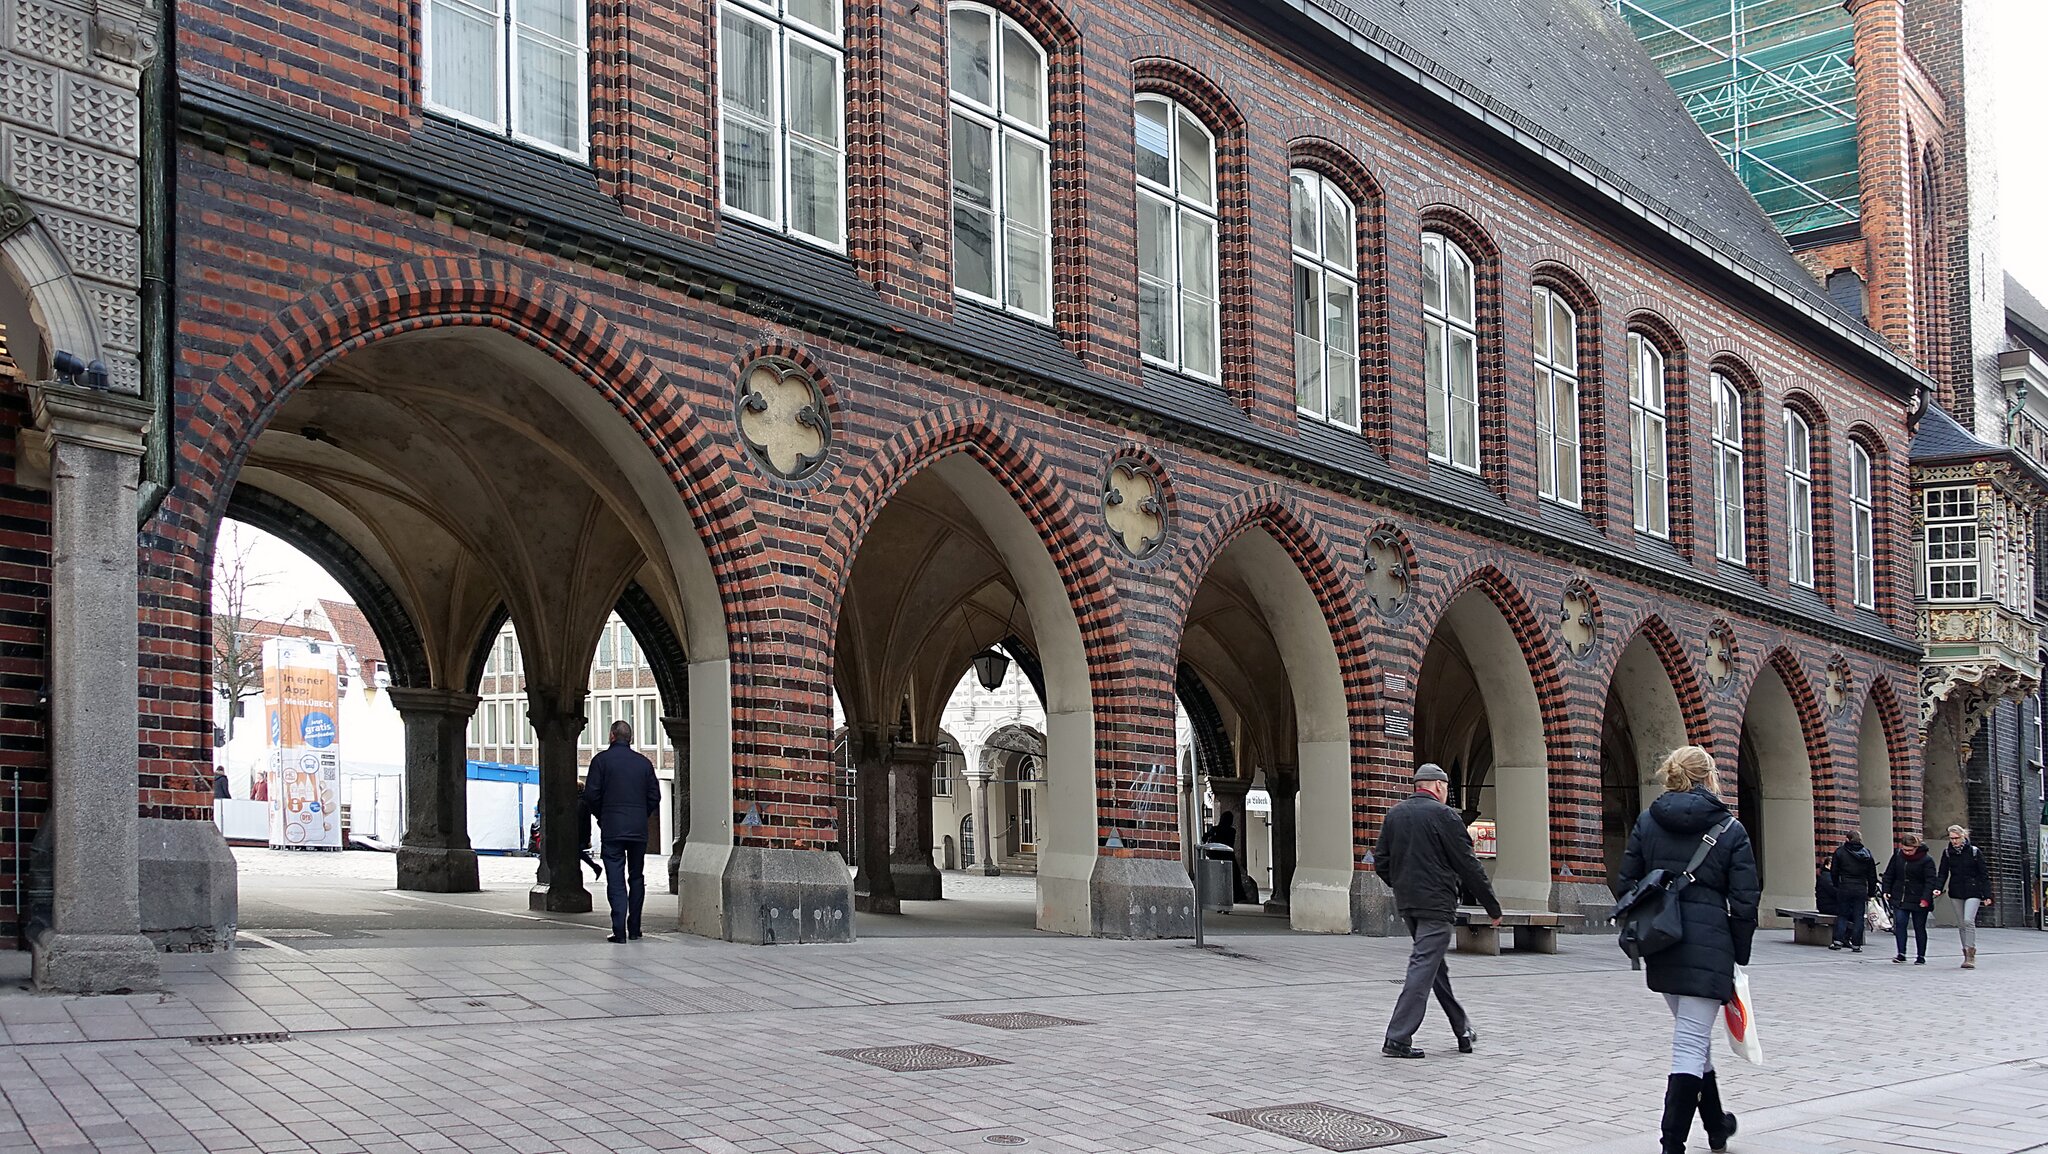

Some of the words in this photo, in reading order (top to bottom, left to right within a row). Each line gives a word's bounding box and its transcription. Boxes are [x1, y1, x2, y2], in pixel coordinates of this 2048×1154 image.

[284, 674, 294, 683] In
[297, 675, 324, 685] einer
[284, 698, 334, 708] MeinLÜBECK
[305, 723, 332, 734] gratis
[1252, 796, 1268, 805] Lübeck
